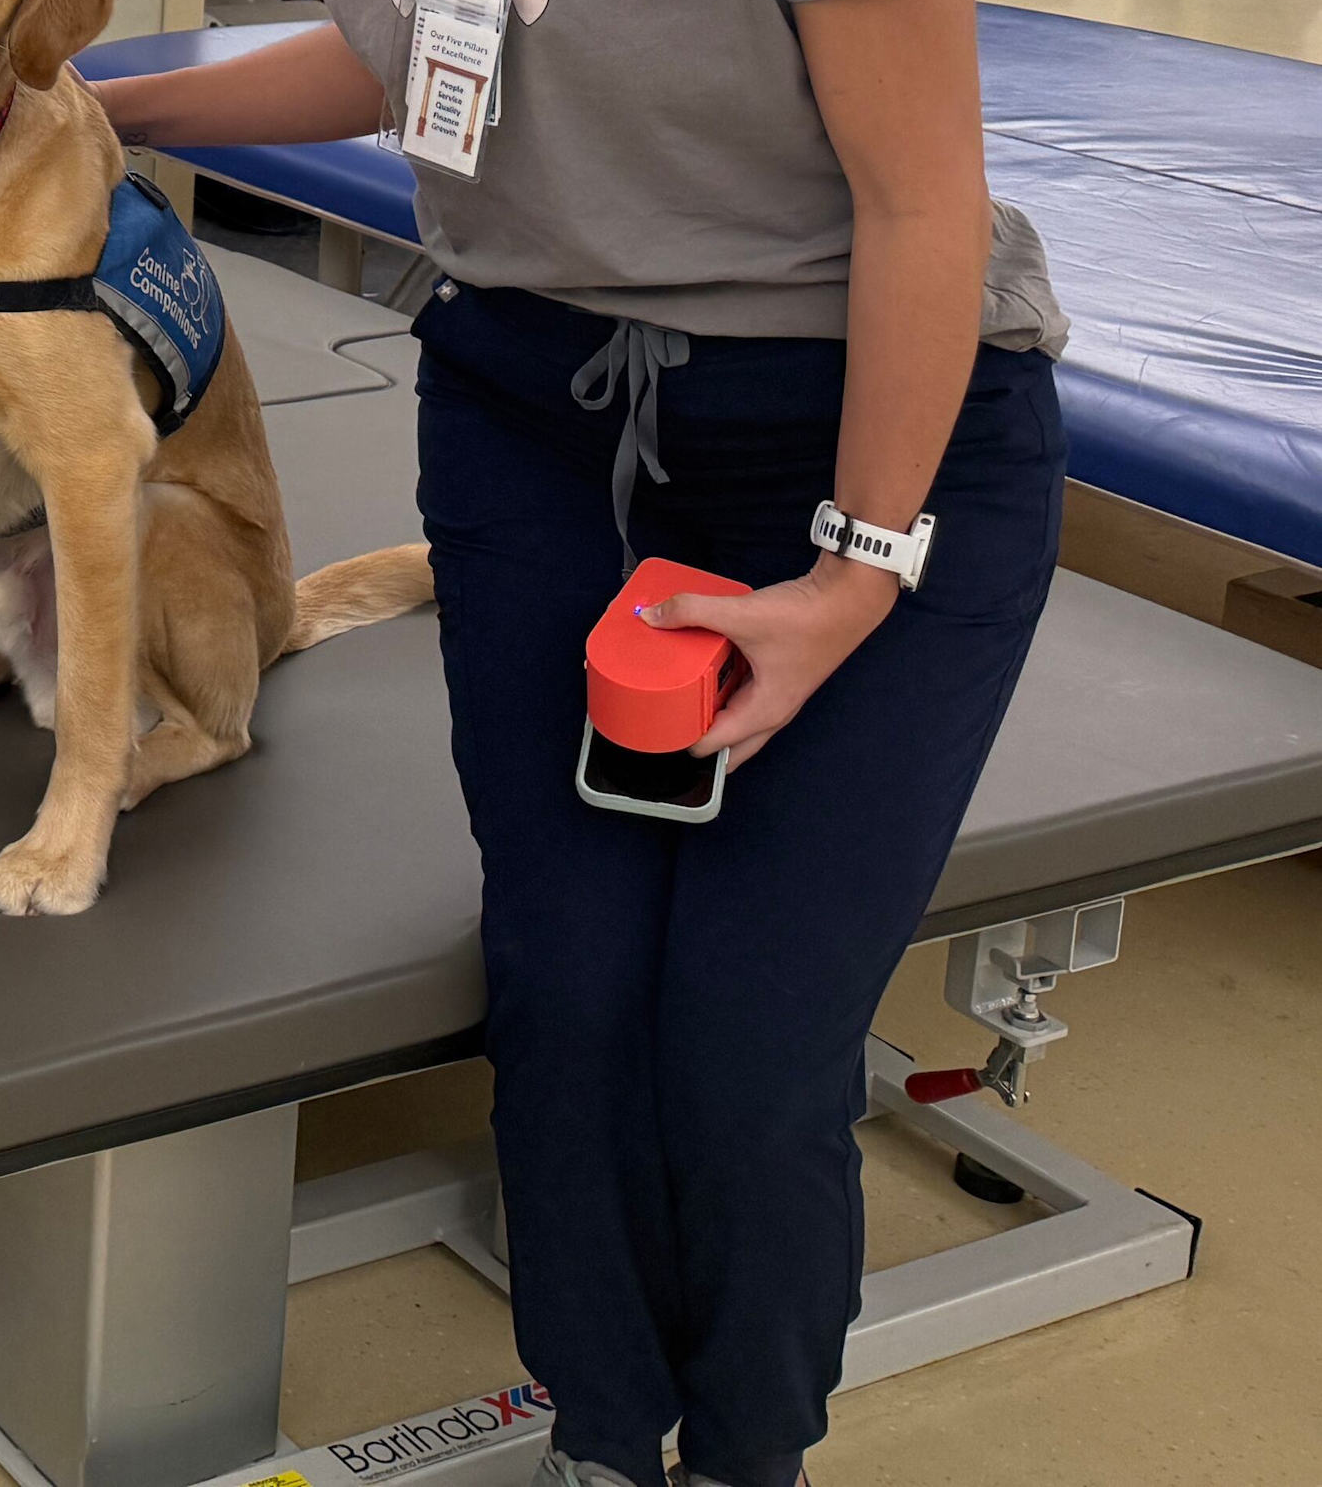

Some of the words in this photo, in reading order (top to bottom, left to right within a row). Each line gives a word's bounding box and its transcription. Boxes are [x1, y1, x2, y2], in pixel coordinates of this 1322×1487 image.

[430, 30, 445, 40] Our
[446, 35, 463, 47] Five
[464, 41, 488, 56] Pillars
[431, 44, 440, 52] of
[441, 46, 482, 66] Excellence
[440, 80, 464, 94] People
[438, 90, 463, 105] Service
[435, 101, 461, 117] Quality
[433, 112, 460, 127] Finance
[431, 122, 457, 137] Growth
[137, 246, 181, 297] Canine
[130, 268, 202, 350] Companions
